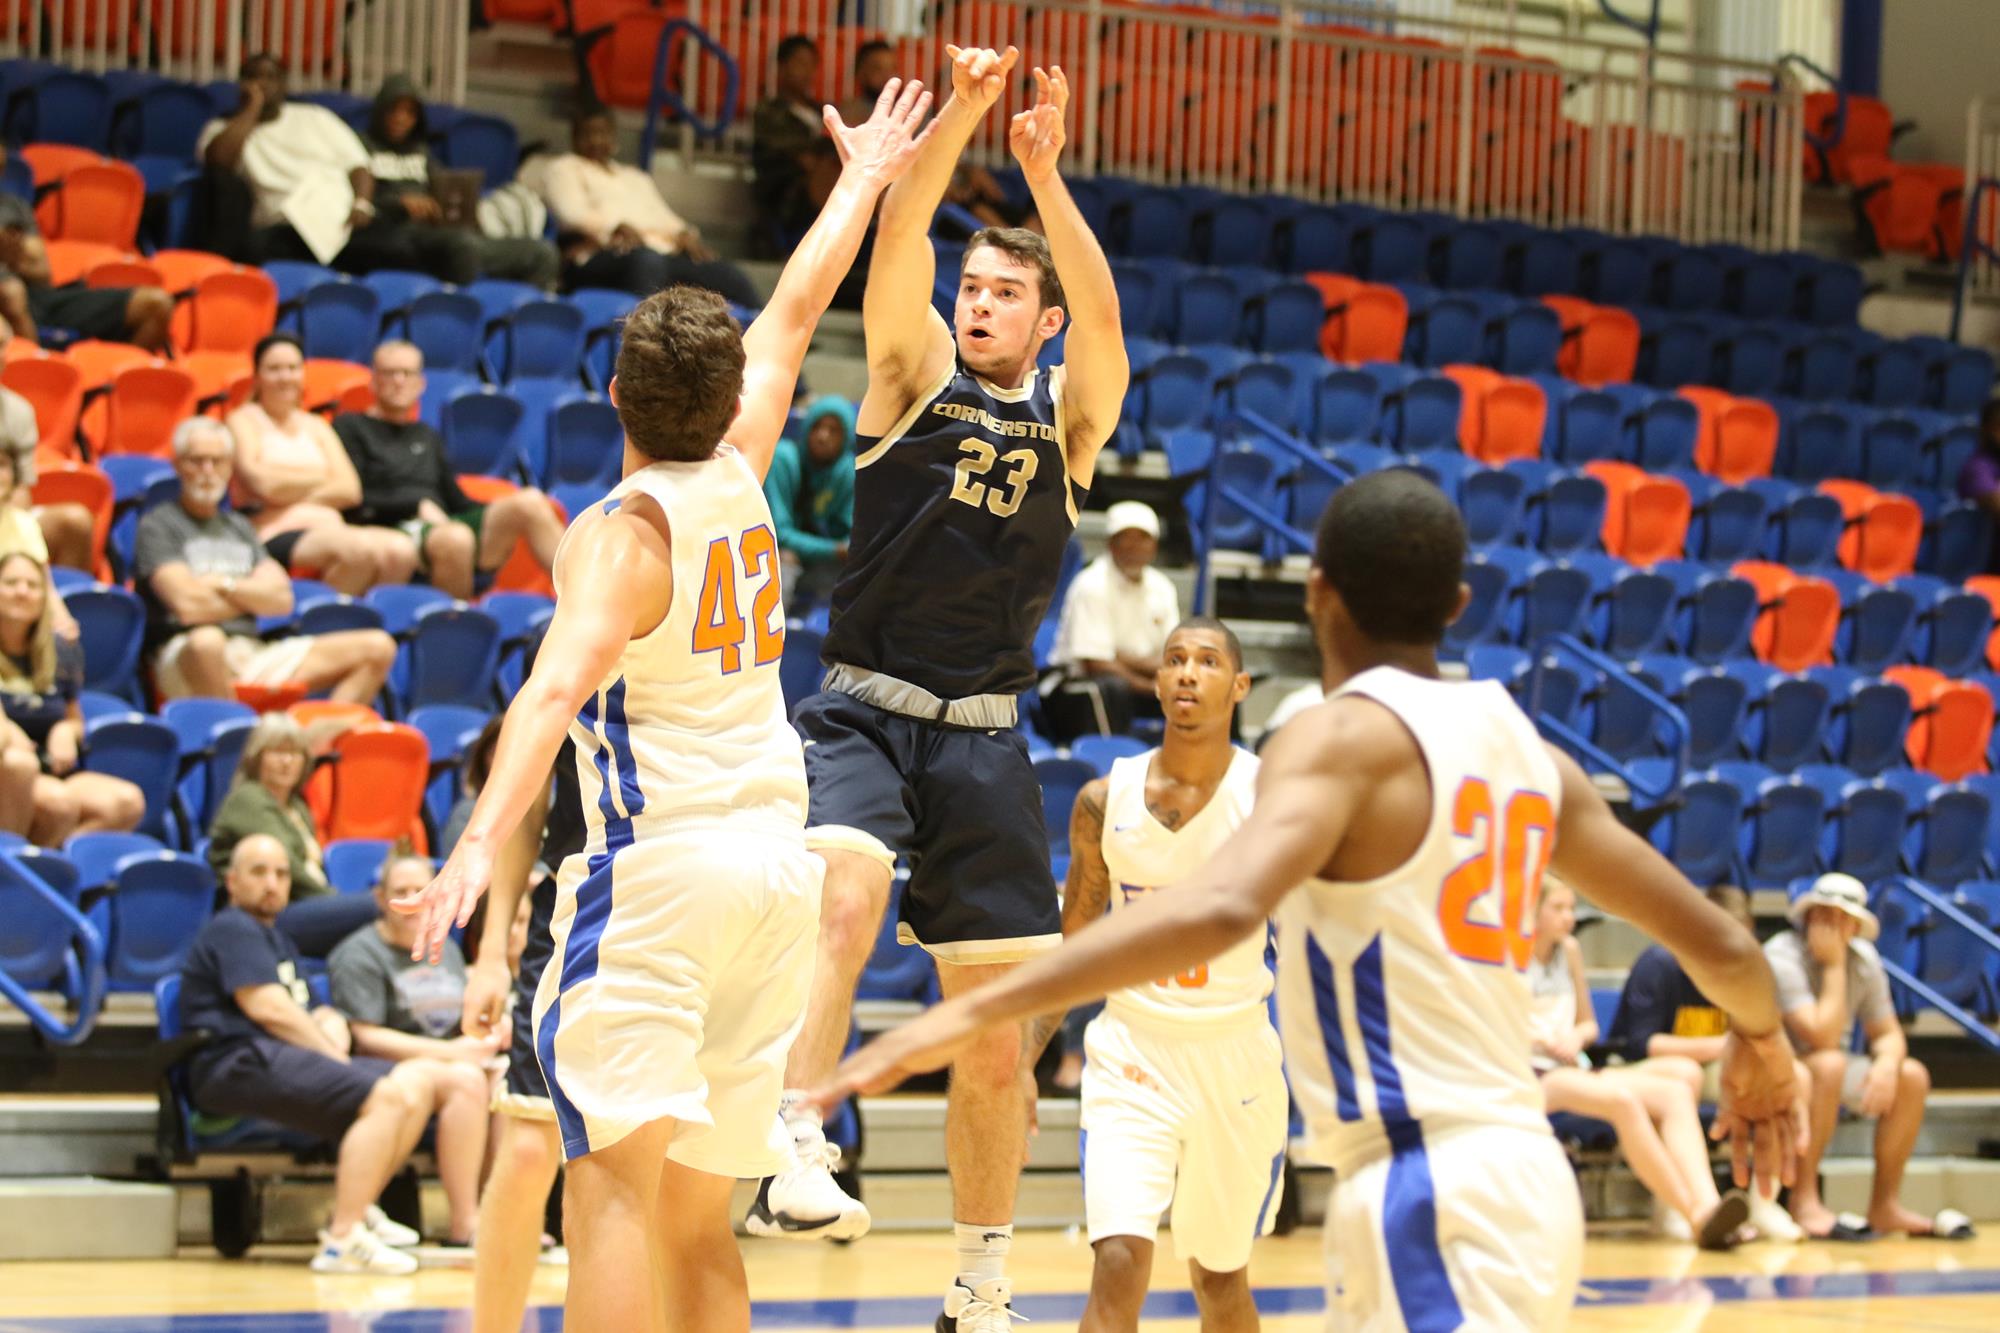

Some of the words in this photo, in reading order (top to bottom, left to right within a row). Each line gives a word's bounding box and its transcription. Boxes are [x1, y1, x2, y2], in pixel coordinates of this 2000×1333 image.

[949, 436, 1039, 518] 23
[692, 523, 784, 675] 42
[1437, 775, 1556, 973] 20
